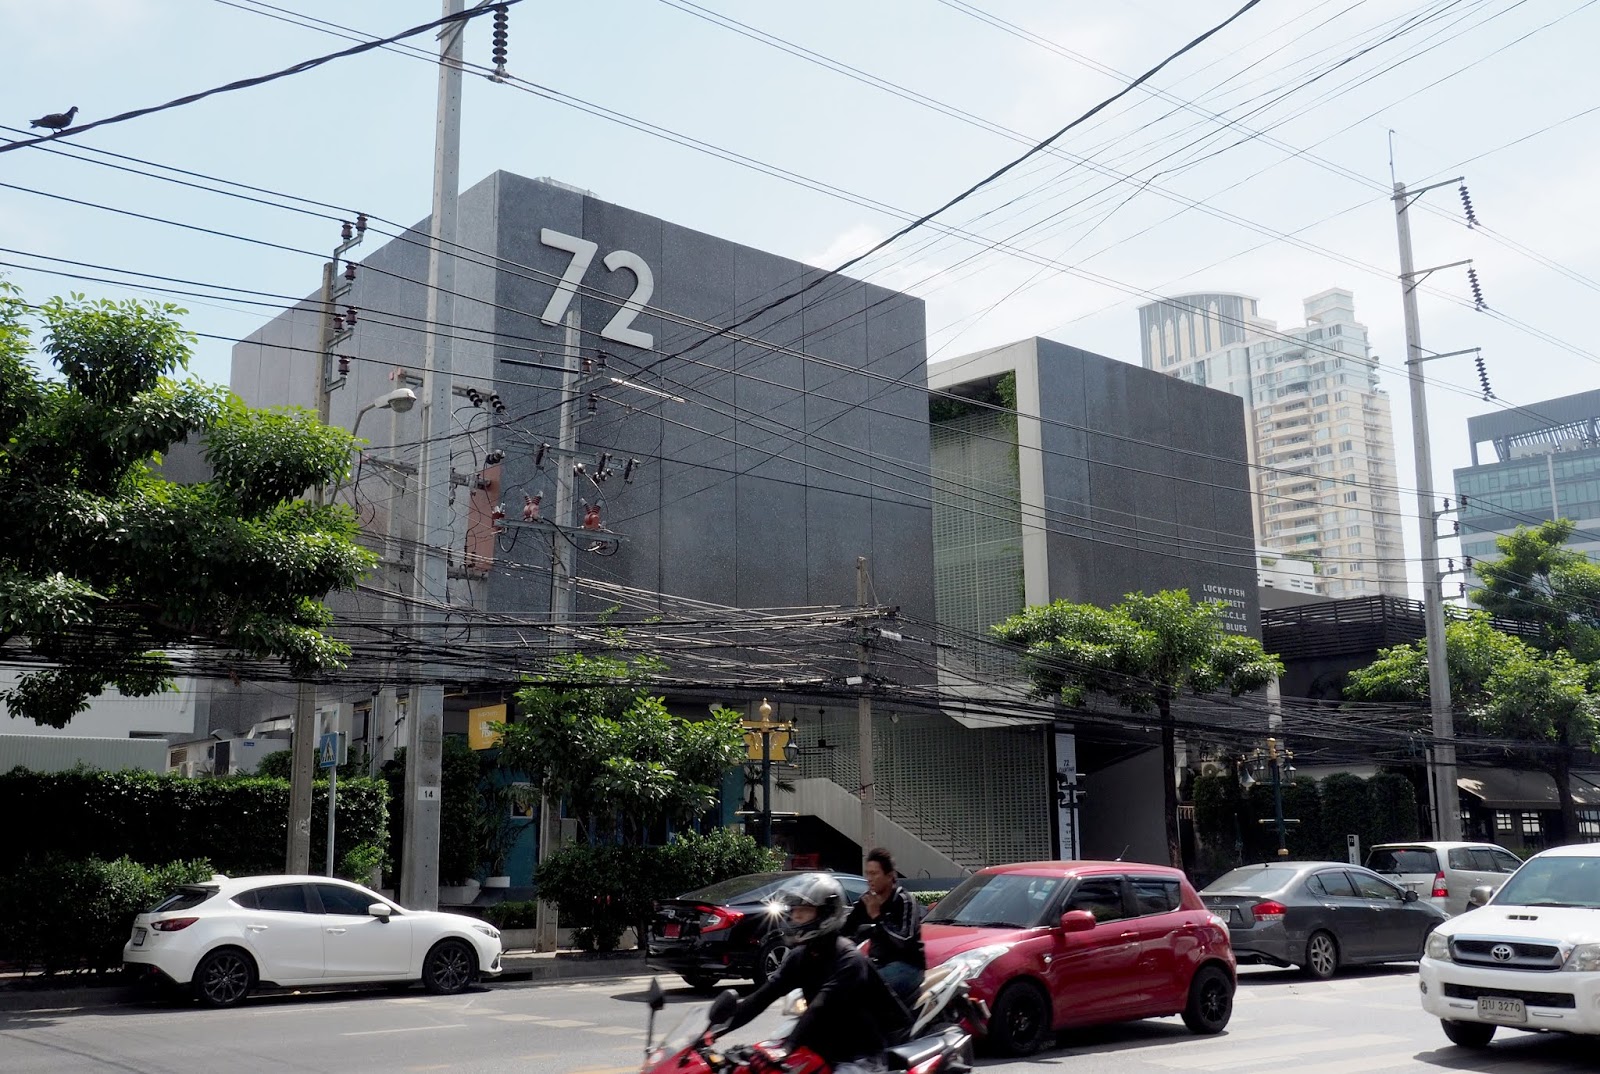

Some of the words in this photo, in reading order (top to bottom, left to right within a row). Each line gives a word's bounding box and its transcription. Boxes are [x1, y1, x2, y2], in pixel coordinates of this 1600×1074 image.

[540, 227, 654, 350] 72
[1203, 584, 1227, 594] LUCKY
[1228, 588, 1245, 597] FISH
[1226, 623, 1247, 632] BLUES
[424, 790, 433, 798] 14
[1498, 1001, 1521, 1012] 3270
